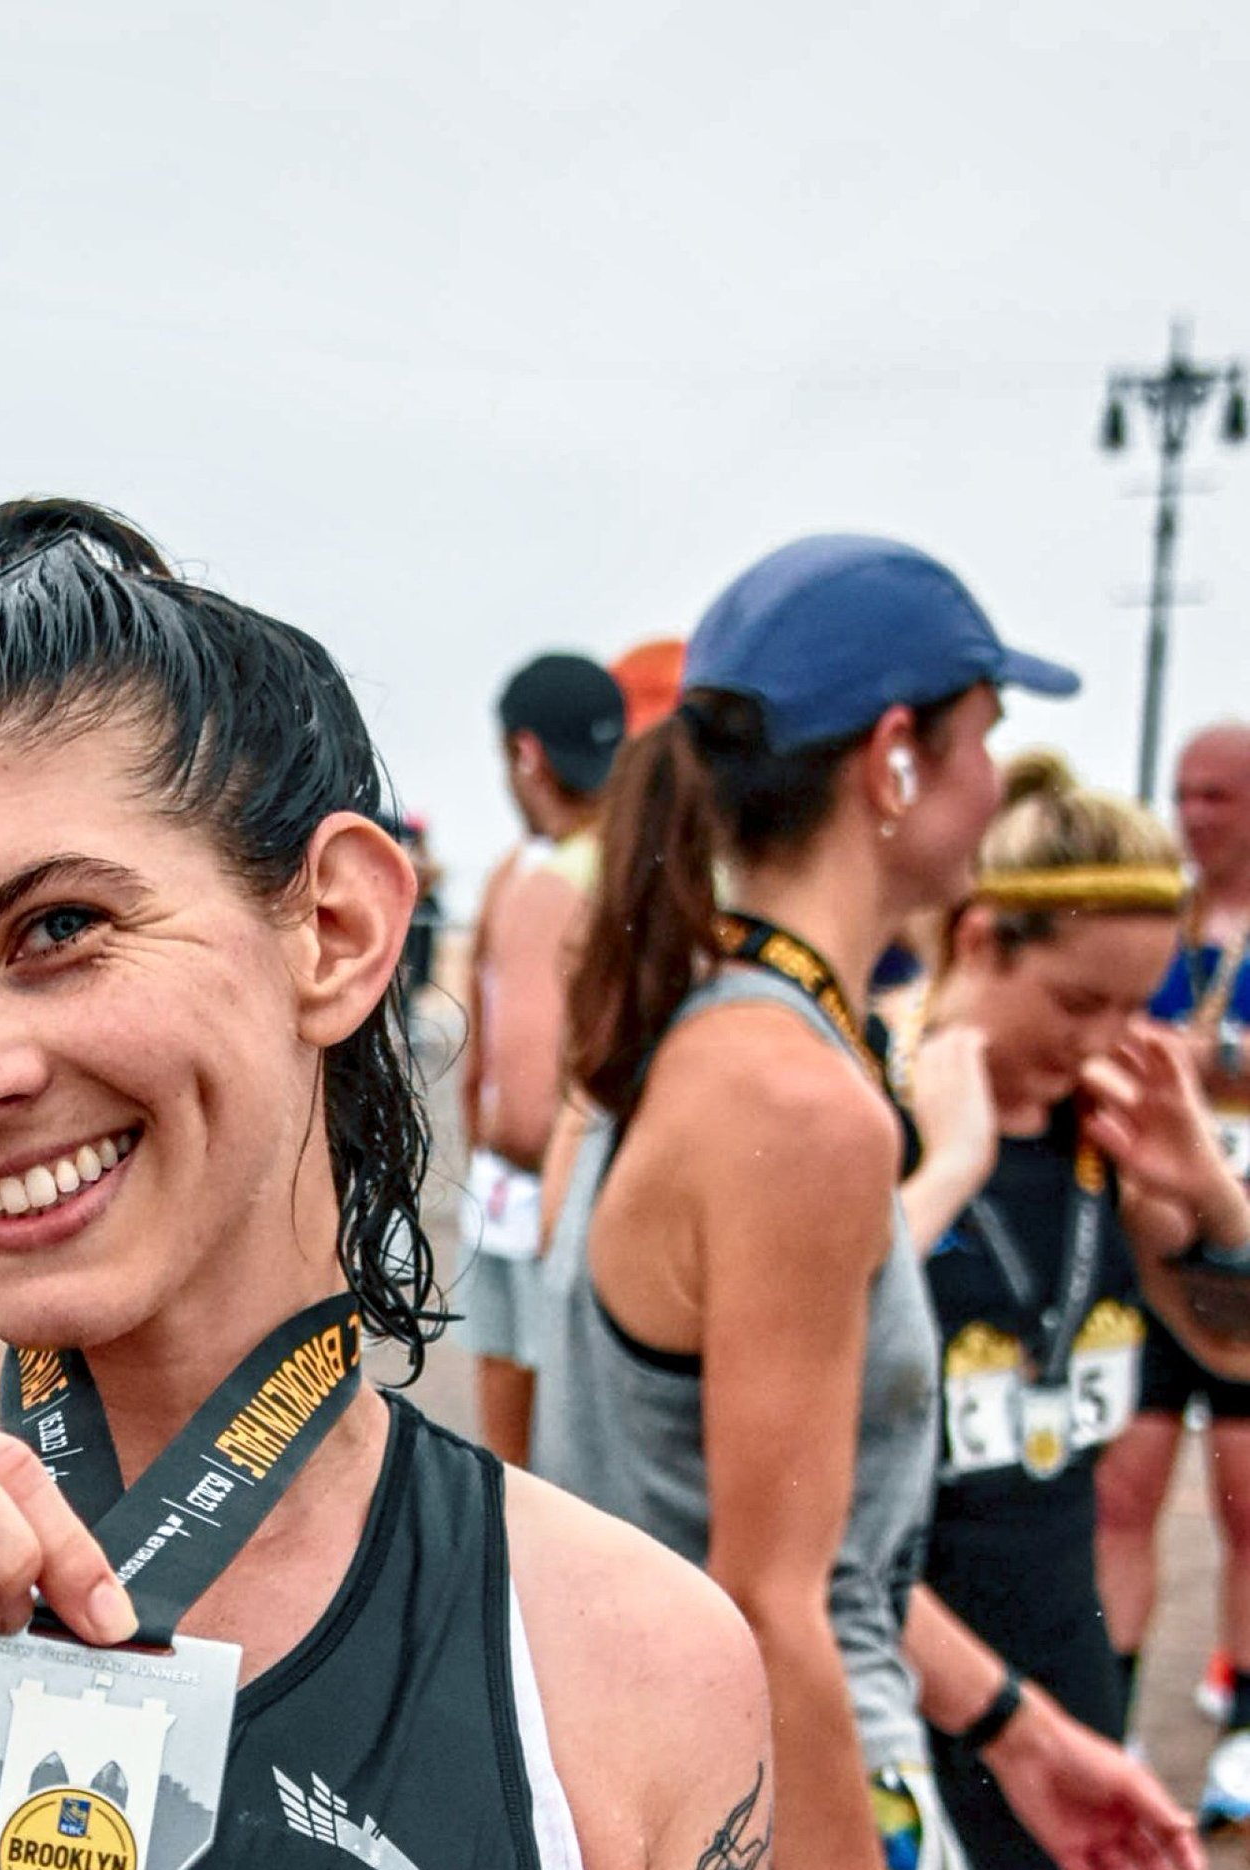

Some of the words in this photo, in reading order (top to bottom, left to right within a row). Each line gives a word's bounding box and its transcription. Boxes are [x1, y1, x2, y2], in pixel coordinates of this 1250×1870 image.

[245, 1324, 346, 1442] BROOKLYN
[214, 1413, 286, 1480] HALF
[186, 1471, 235, 1512] 05.20.23
